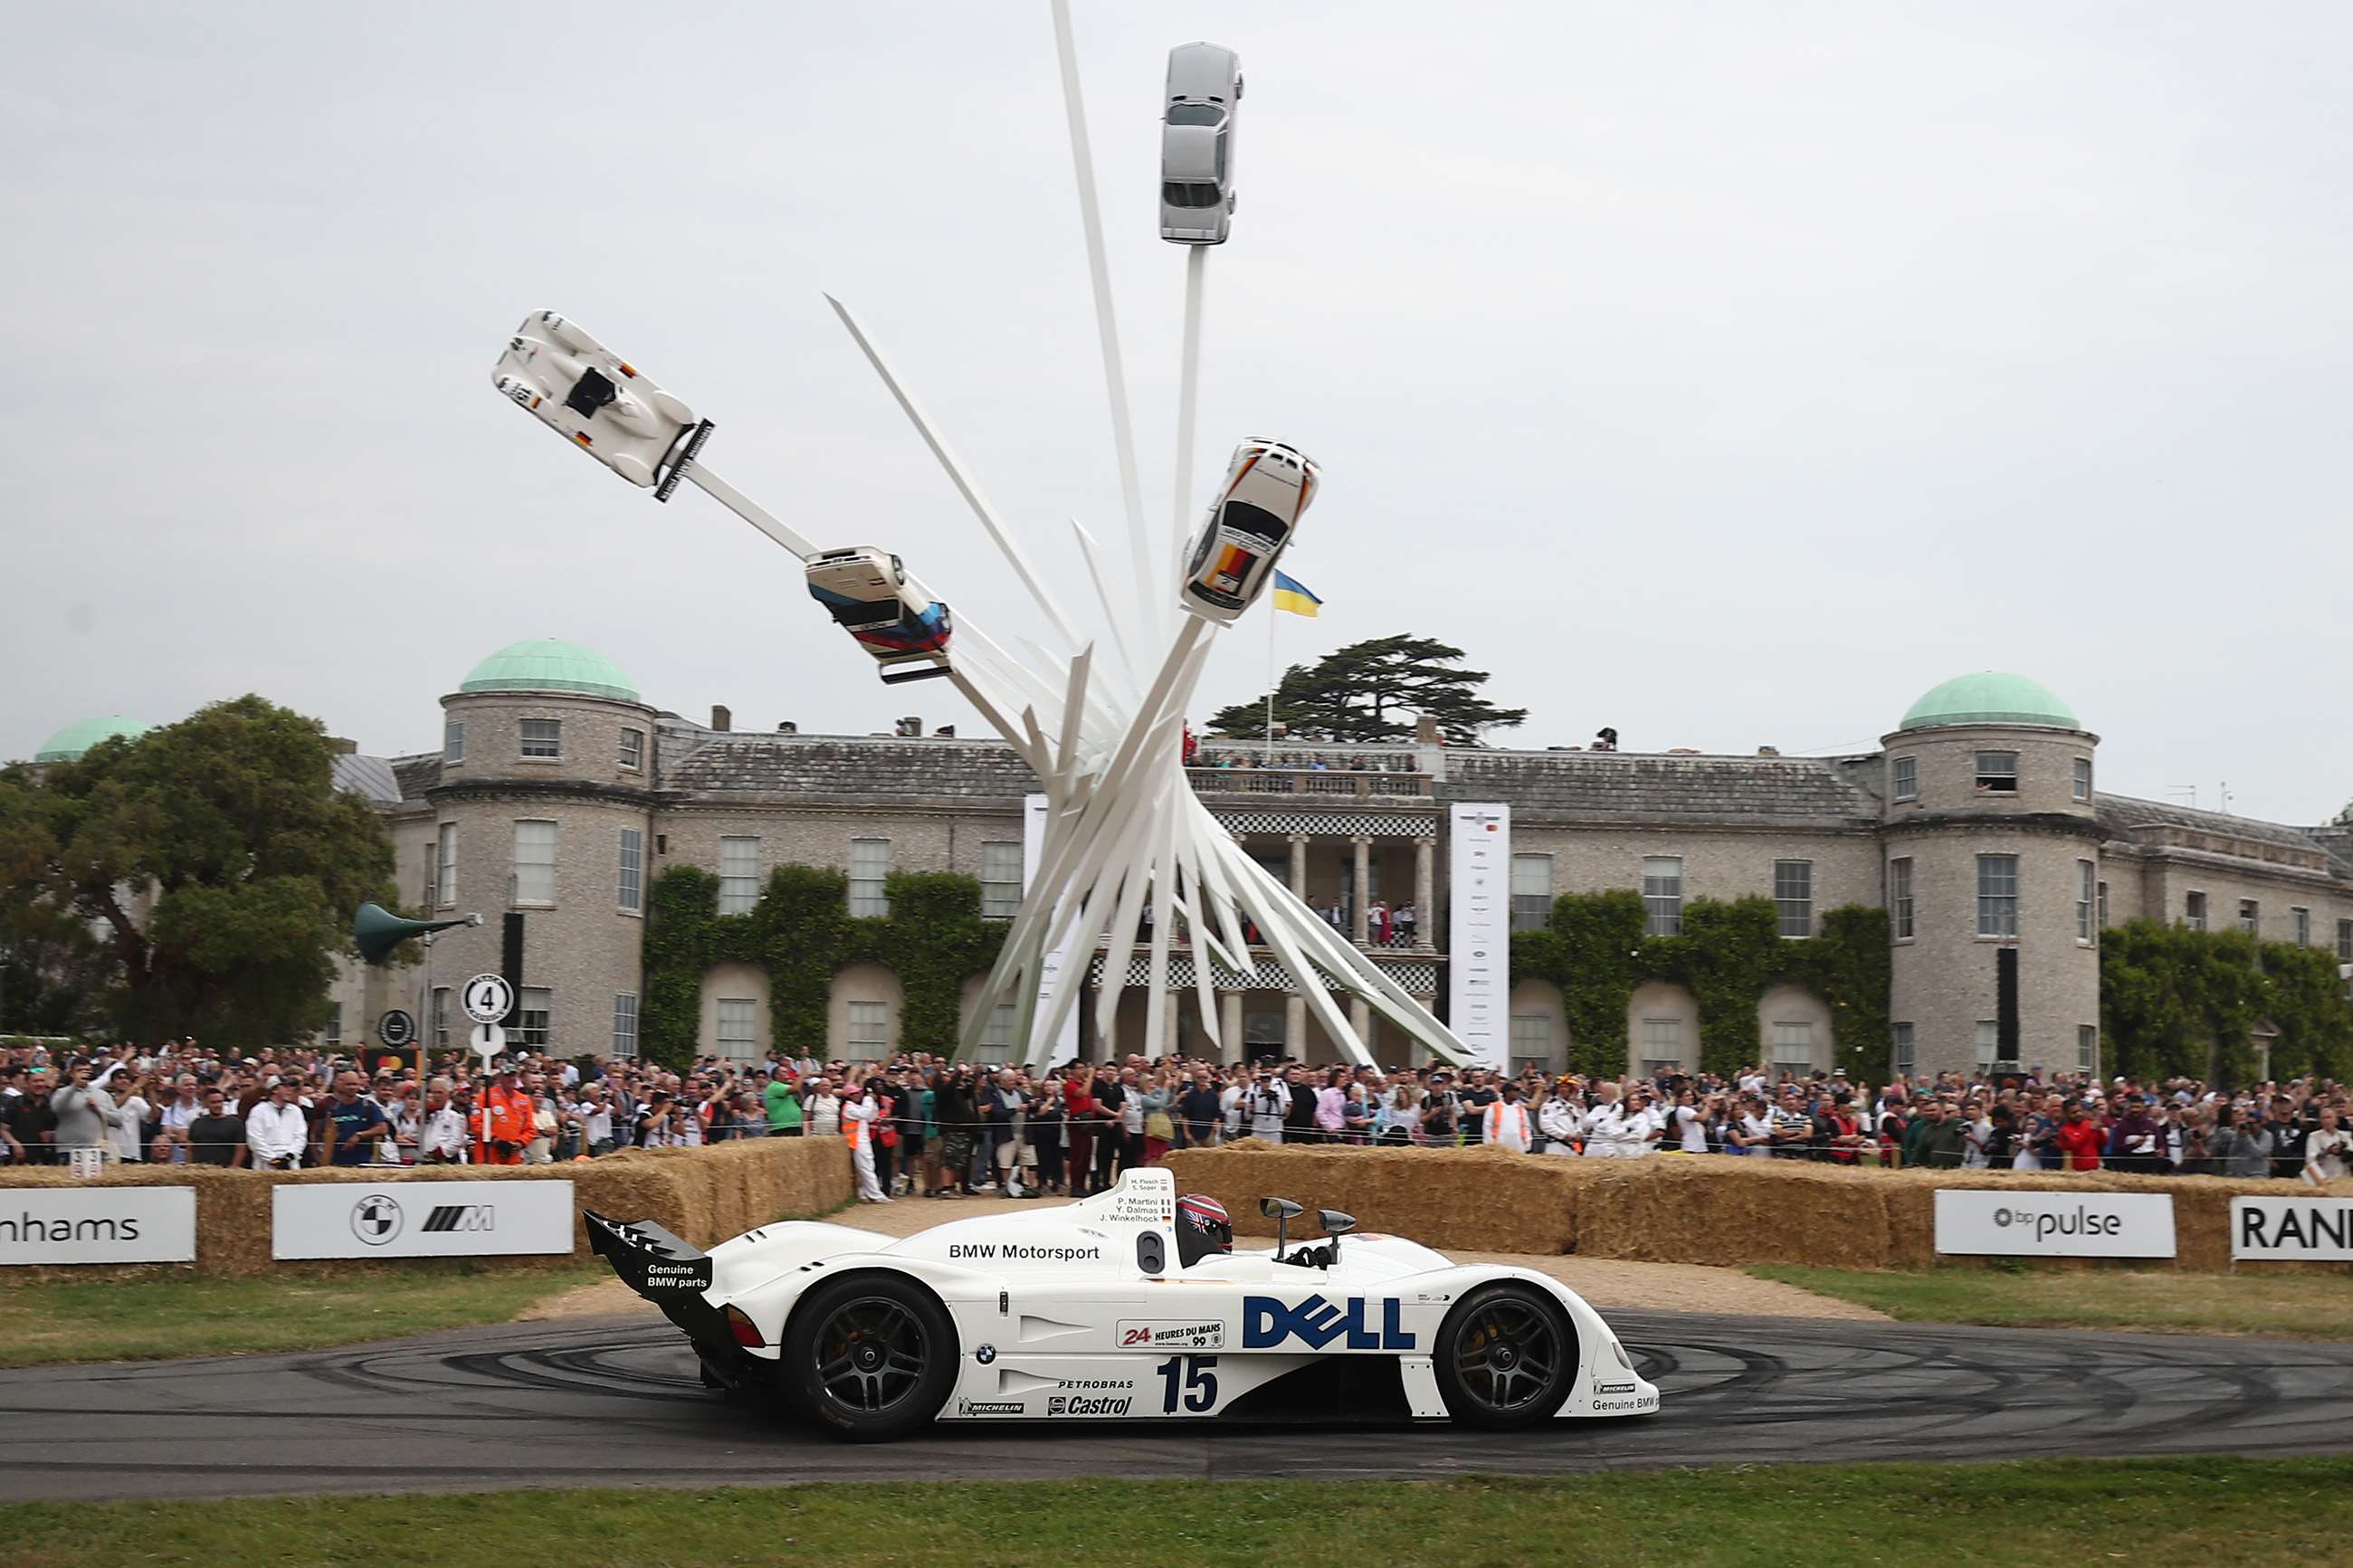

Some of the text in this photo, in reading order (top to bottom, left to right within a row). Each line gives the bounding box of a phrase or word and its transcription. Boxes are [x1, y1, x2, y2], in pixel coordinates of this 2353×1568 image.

[480, 986, 494, 1011] 4
[1127, 1206, 1158, 1214] Dalmas
[1109, 1214, 1159, 1222] Winkelhock
[2015, 1205, 2121, 1242] bp pulse
[949, 1244, 1100, 1261] BMW Motorsport
[647, 1265, 694, 1275] Genuine
[647, 1277, 708, 1288] BMW parts
[1243, 1294, 1416, 1350] DELL
[1123, 1324, 1221, 1345] 24 HEURES DU MANS
[1193, 1336, 1206, 1346] 99
[1058, 1380, 1134, 1389] PETROBRAS
[1157, 1356, 1218, 1413] 15
[1068, 1396, 1132, 1416] Castrol
[1593, 1399, 1635, 1410] Genuine
[1637, 1397, 1655, 1408] BMW
